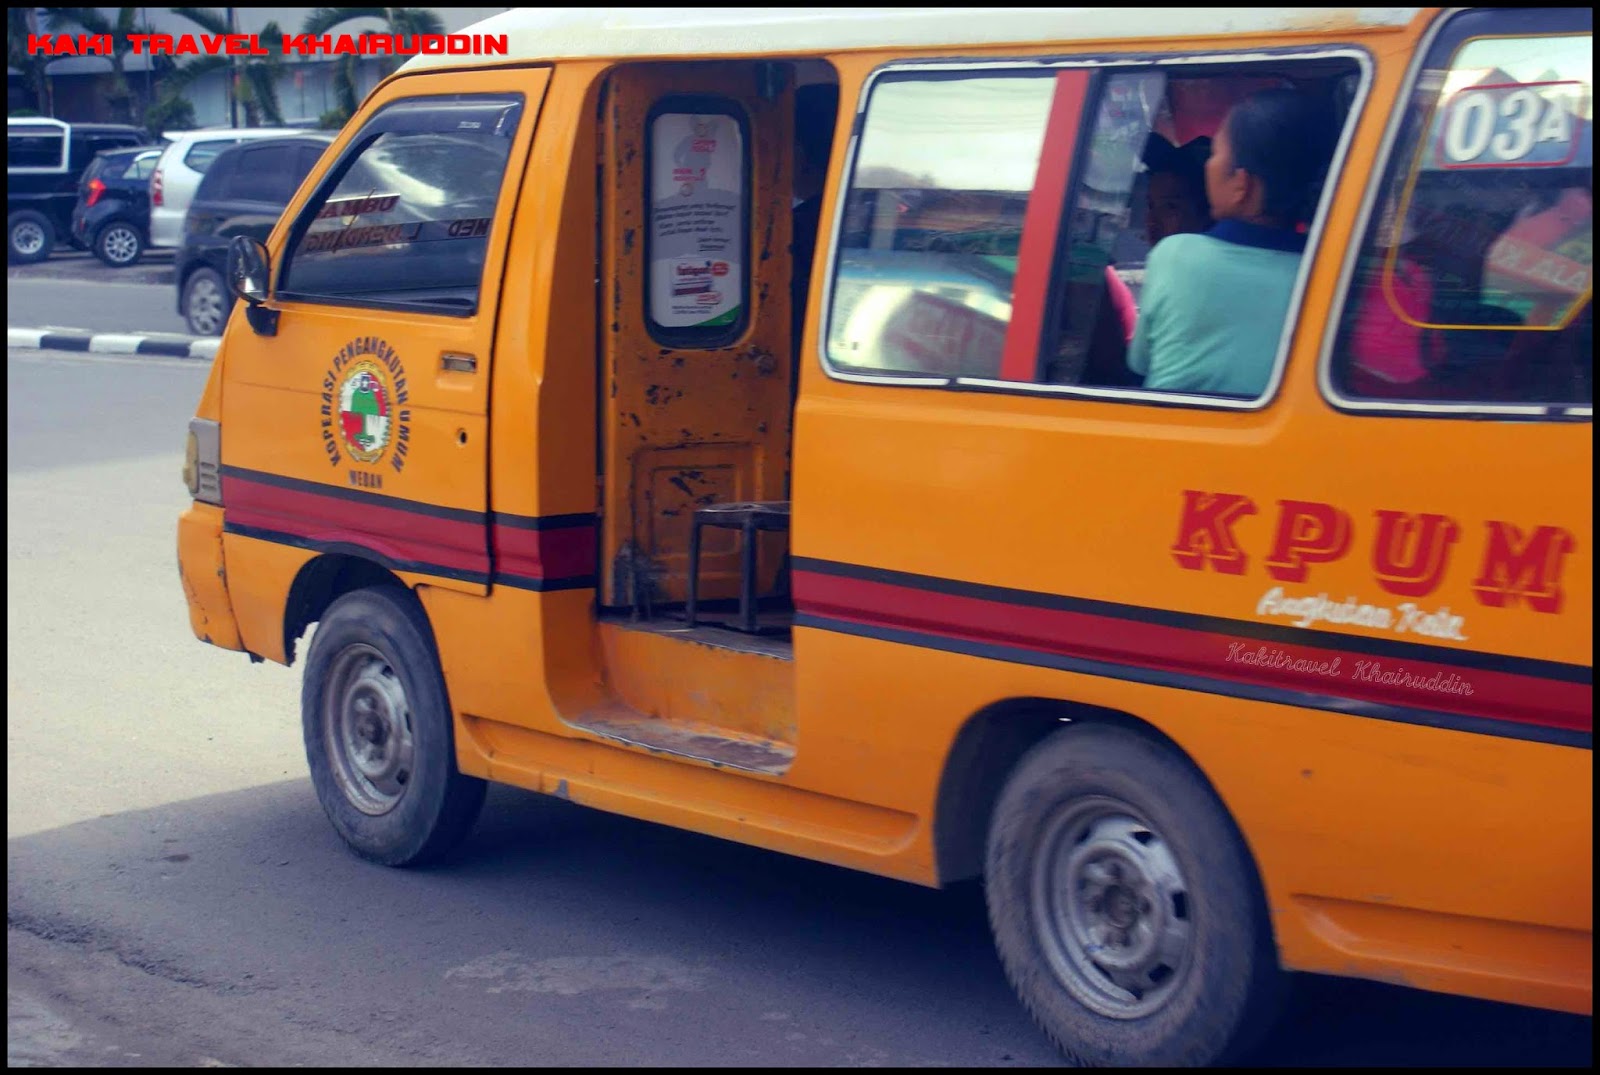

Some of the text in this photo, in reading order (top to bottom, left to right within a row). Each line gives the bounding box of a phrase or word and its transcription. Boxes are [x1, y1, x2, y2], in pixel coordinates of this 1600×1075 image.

[1445, 88, 1571, 162] 03A
[321, 336, 411, 473] KOPERASI PENGANGKUTAN UMUM
[349, 469, 383, 489] MEDAN
[1170, 489, 1579, 614] KPUM
